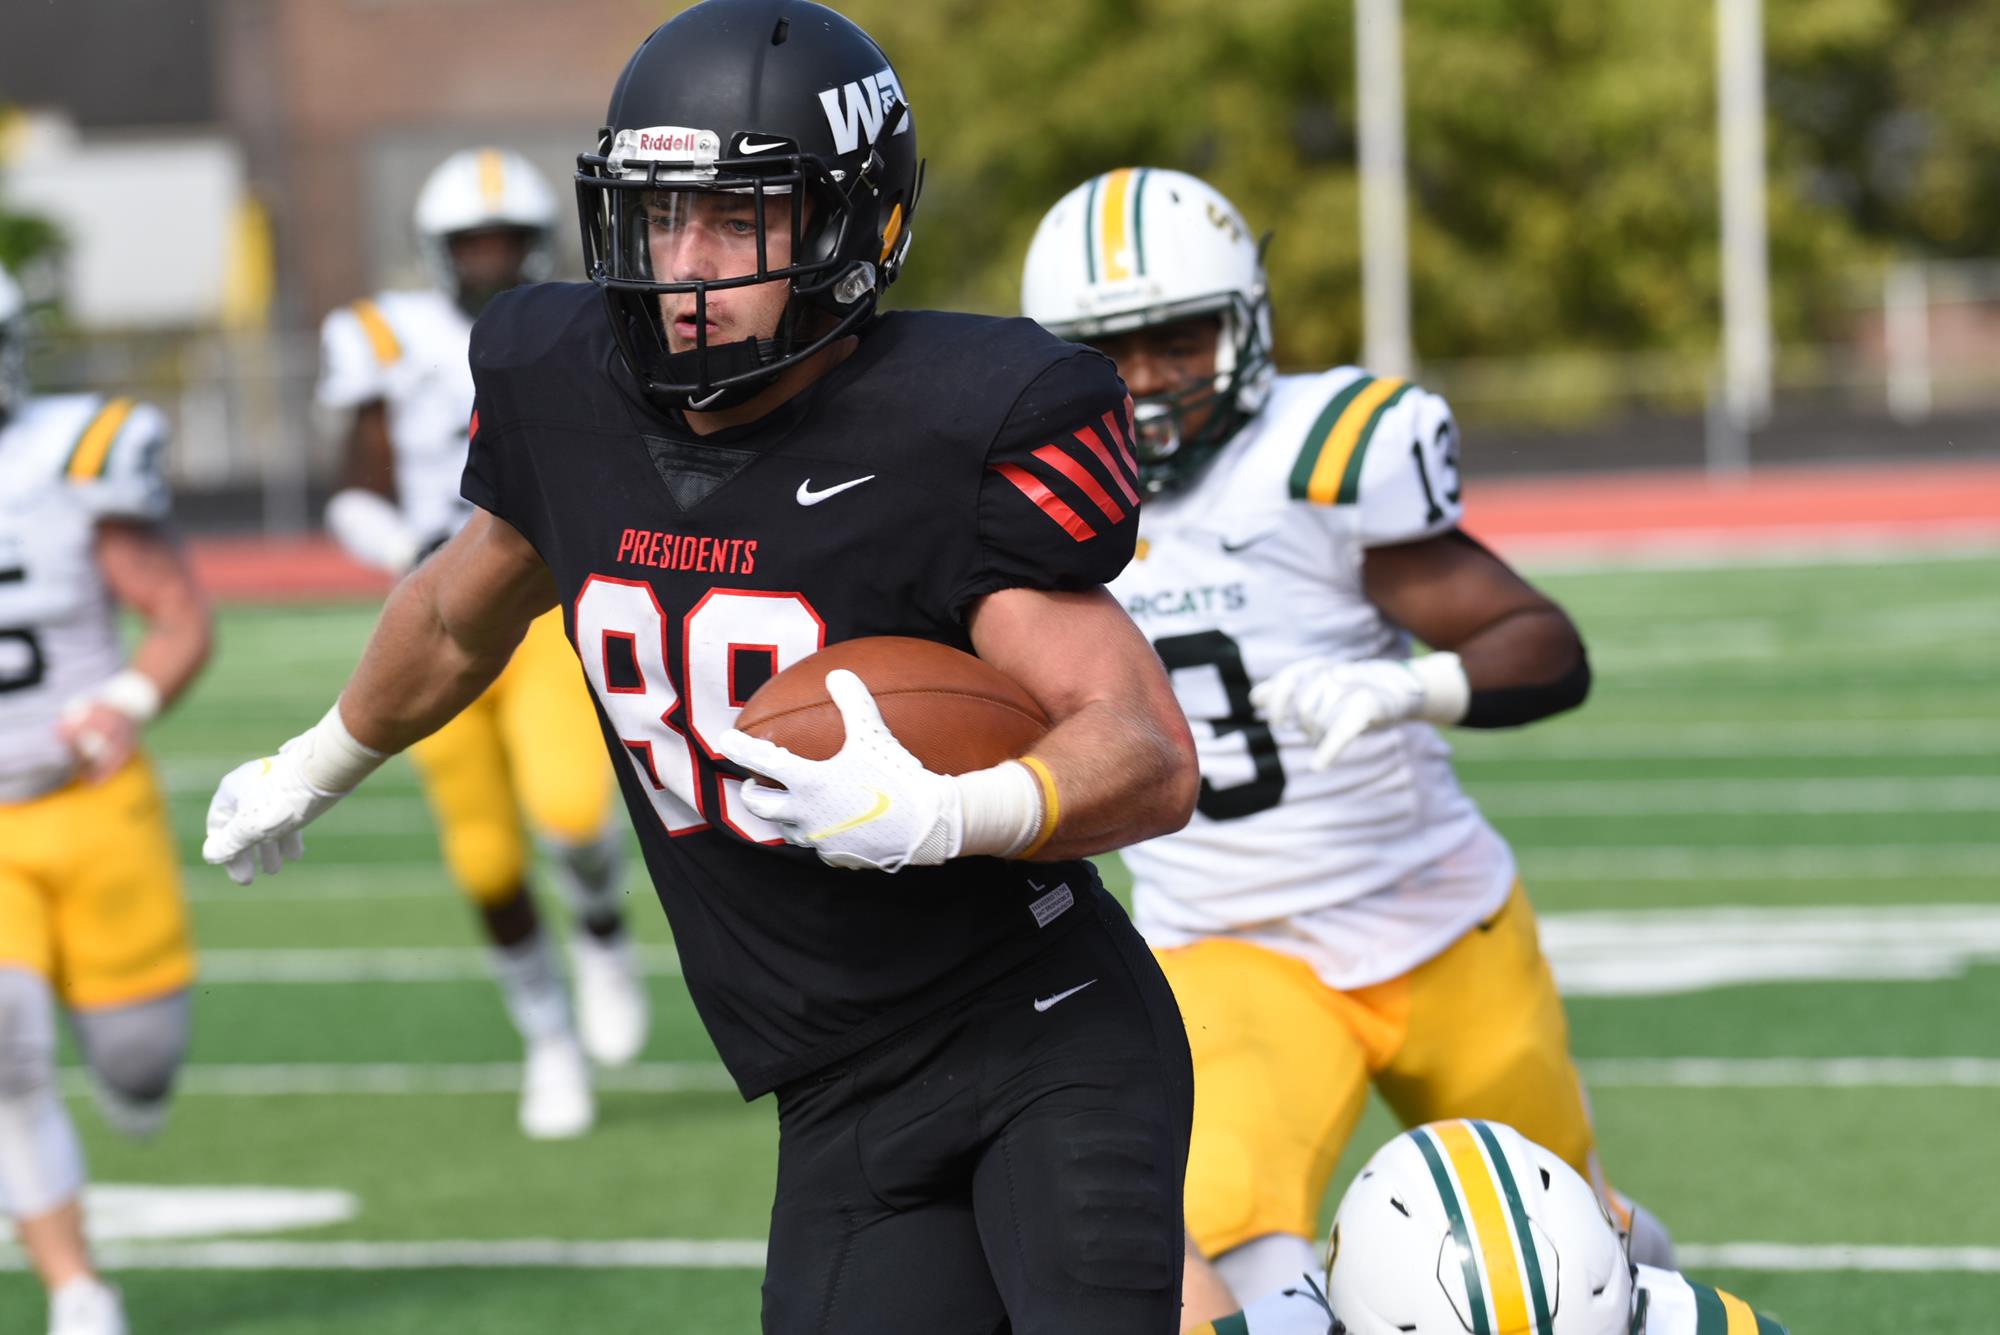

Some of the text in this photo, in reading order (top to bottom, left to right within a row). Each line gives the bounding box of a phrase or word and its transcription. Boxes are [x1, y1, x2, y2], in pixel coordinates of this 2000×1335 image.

[640, 134, 694, 151] Riddell
[1412, 422, 1461, 523] 13
[617, 529, 757, 573] PRESIDENTS
[1128, 584, 1246, 620] RCATS
[575, 574, 826, 846] 89
[1153, 629, 1286, 820] 3
